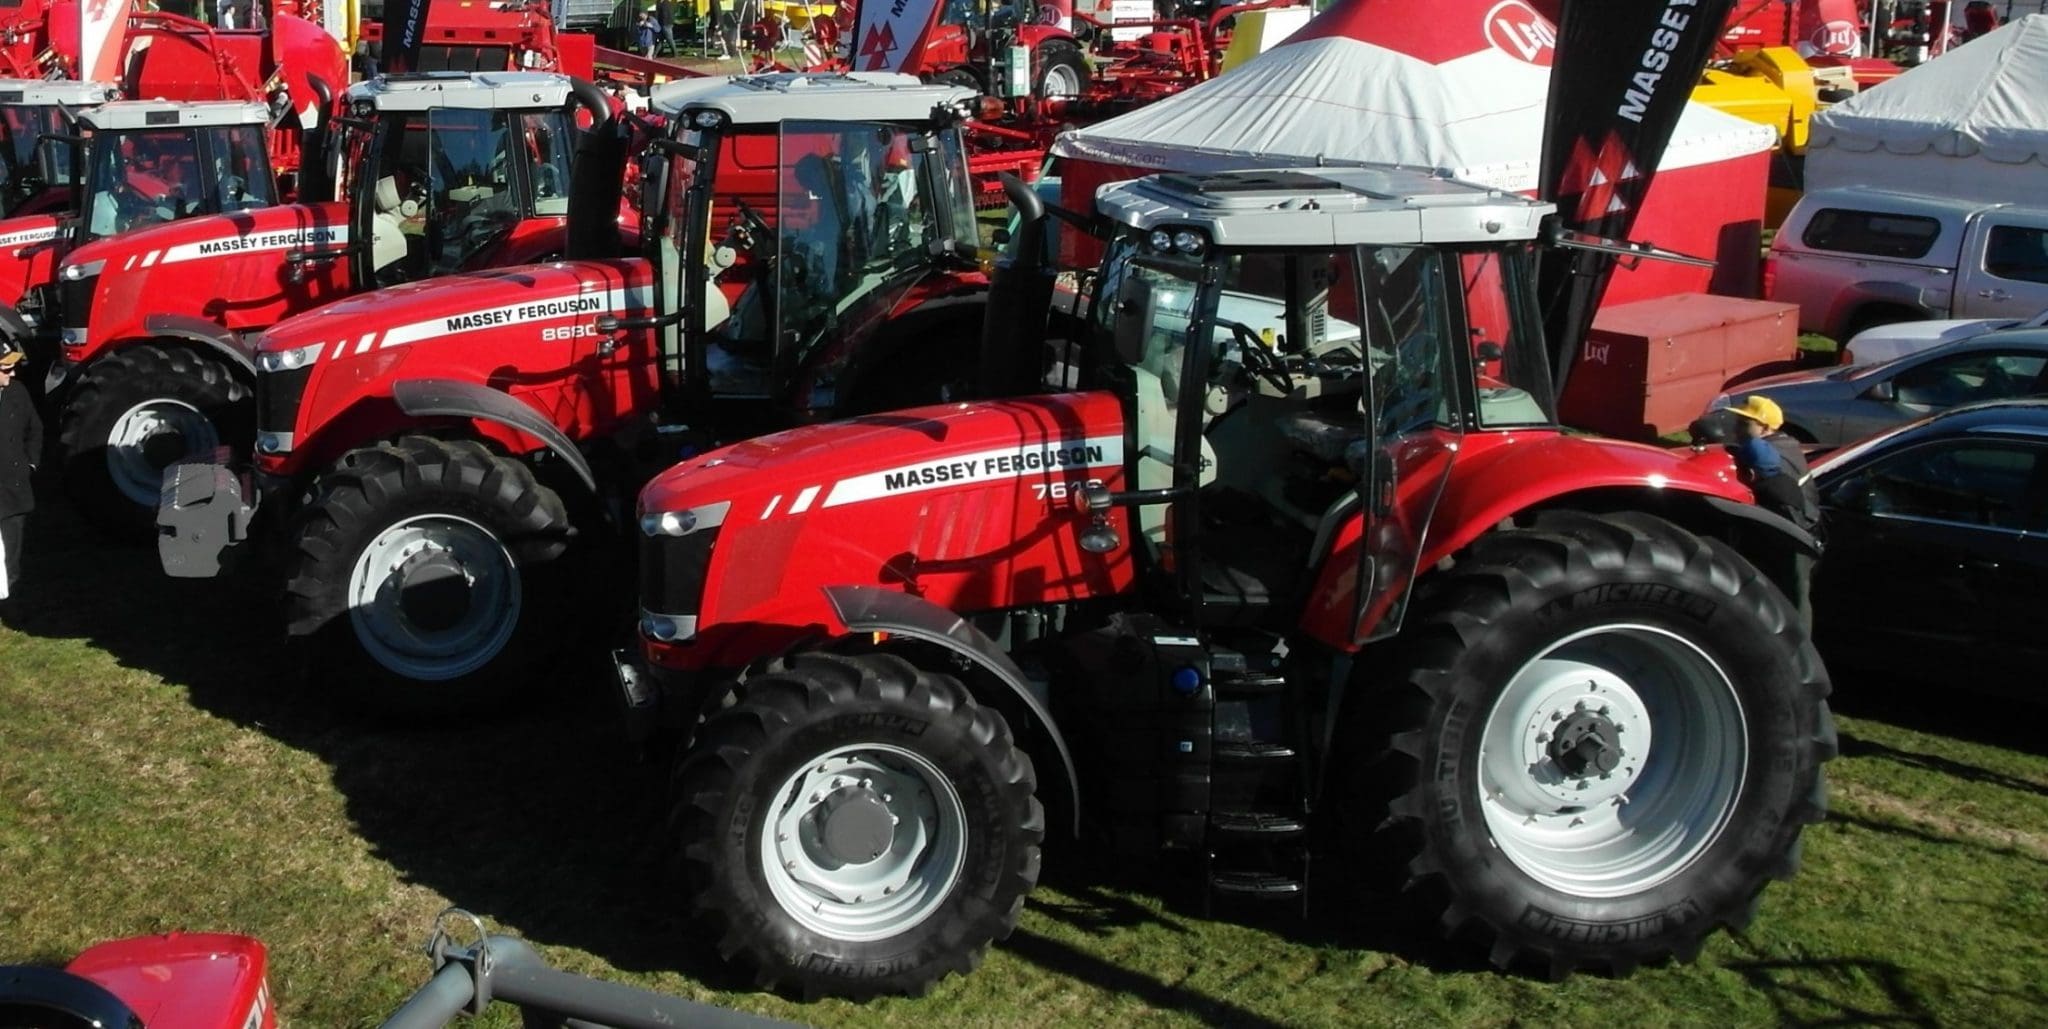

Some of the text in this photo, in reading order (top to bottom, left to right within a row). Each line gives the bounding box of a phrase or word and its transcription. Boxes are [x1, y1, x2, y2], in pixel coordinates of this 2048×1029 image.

[20, 229, 62, 241] FERGUSO
[200, 231, 335, 254] MASSEY FERGUSON
[447, 298, 600, 331] MASSEY FERGUSON
[885, 446, 1103, 491] MASSEY FERGUSON
[1572, 583, 1717, 622] MICHELIN
[1520, 904, 1664, 943] MICHELIN
